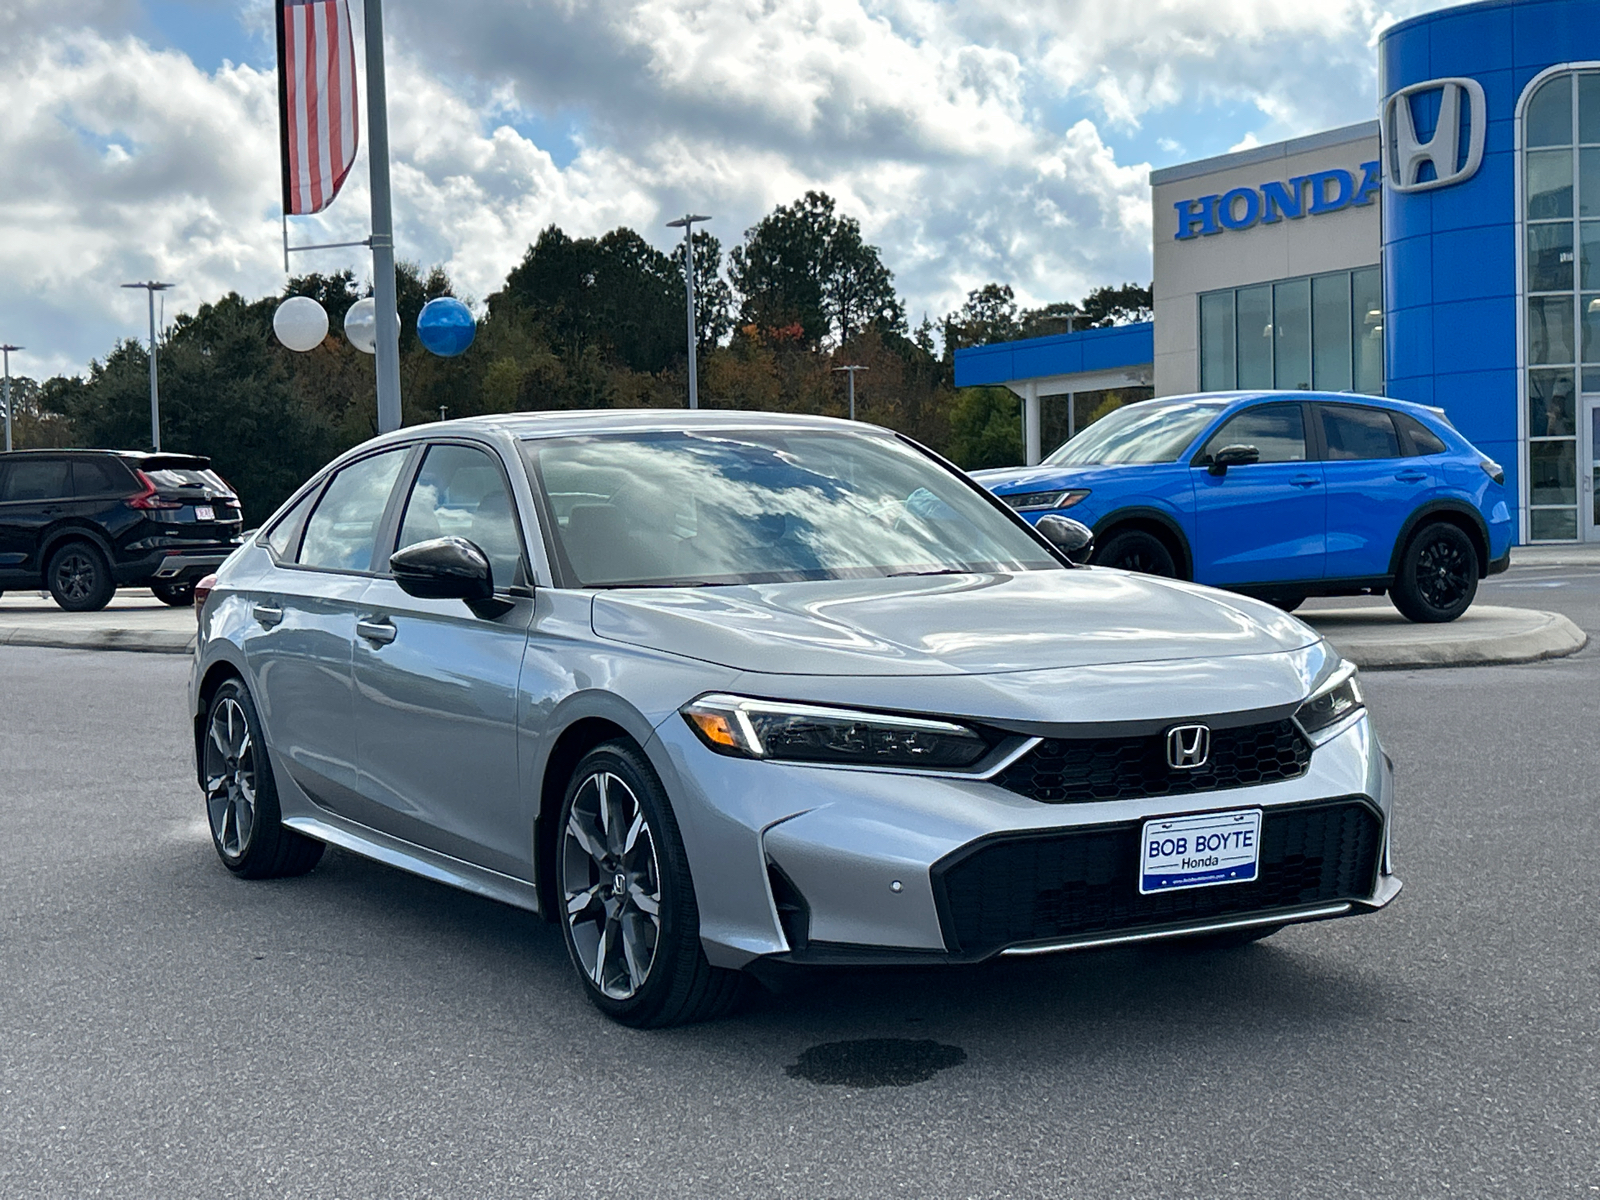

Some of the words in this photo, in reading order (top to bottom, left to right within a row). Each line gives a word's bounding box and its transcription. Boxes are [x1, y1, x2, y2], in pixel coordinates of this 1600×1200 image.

[1174, 161, 1380, 240] HONDA
[1149, 837, 1187, 858] BOB
[1195, 830, 1254, 852] BOYTE
[1181, 855, 1219, 870] Honda
